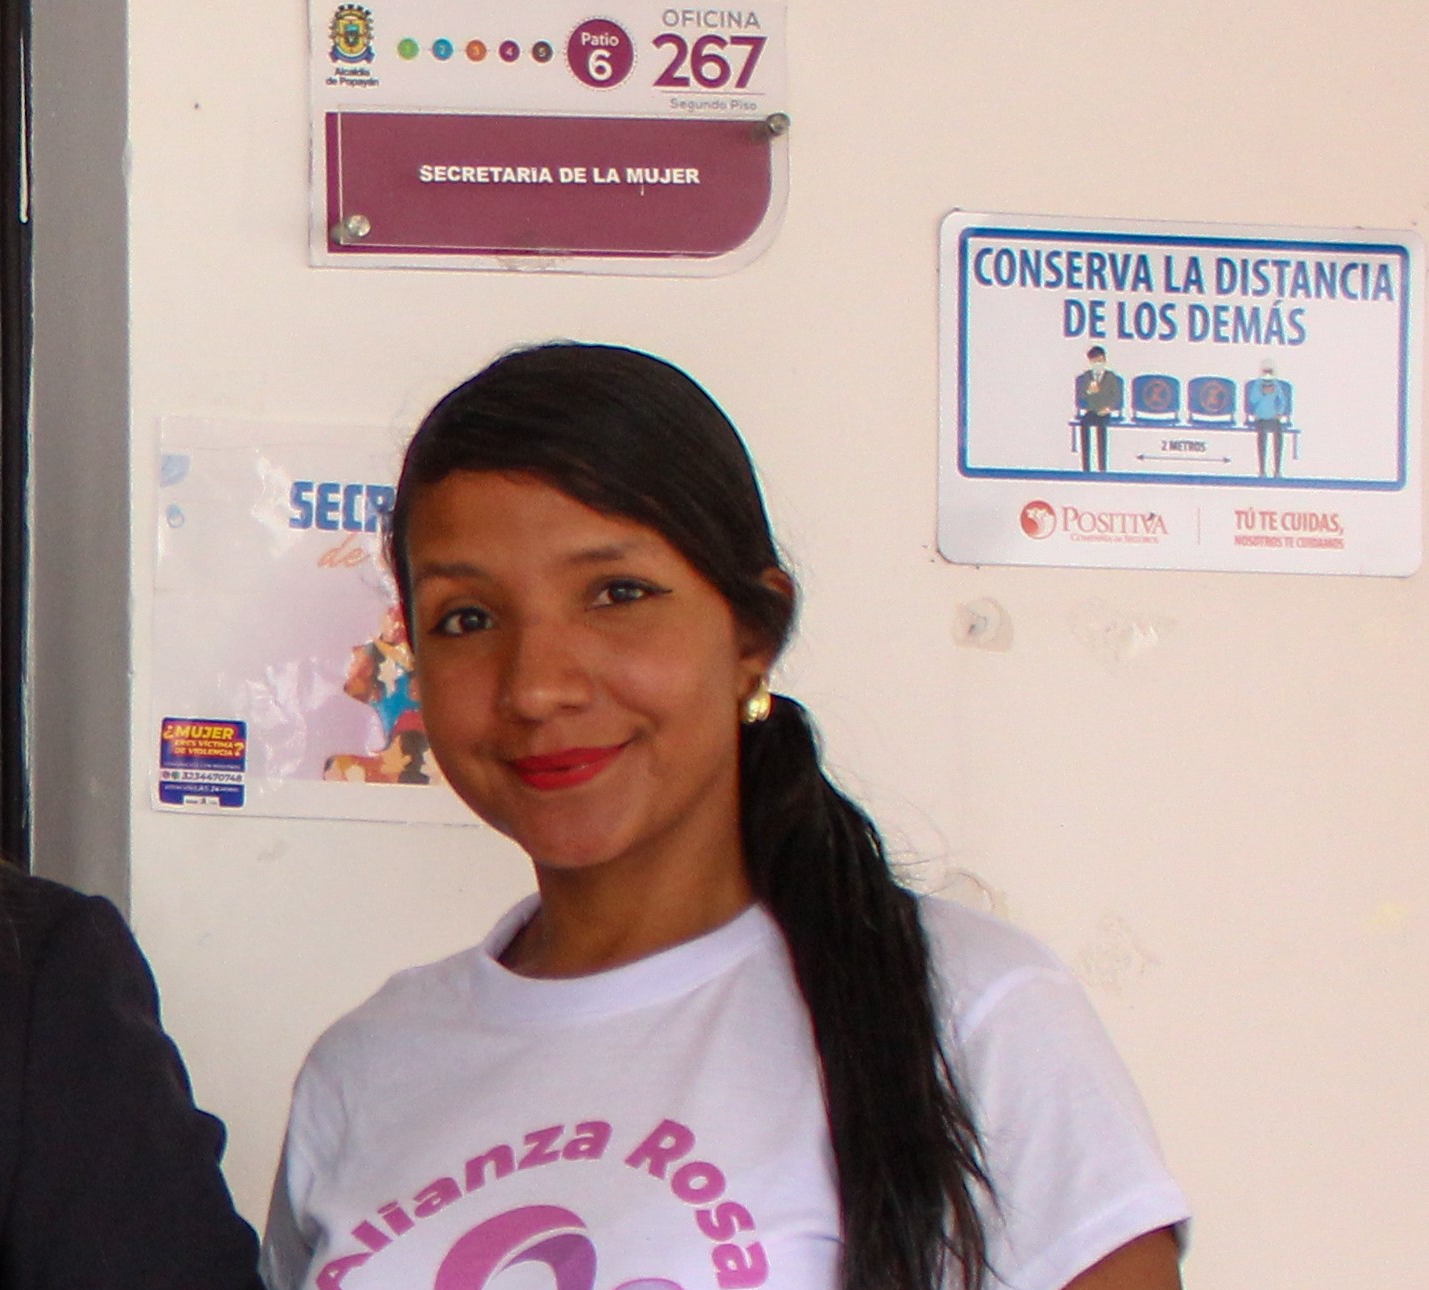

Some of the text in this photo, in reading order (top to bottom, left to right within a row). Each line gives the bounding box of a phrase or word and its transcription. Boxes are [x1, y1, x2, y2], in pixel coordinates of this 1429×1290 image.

[662, 9, 761, 29] OFICINA
[581, 32, 619, 47] Patio
[588, 49, 613, 81] 6
[652, 33, 768, 89] 267
[670, 98, 757, 112] Segundo Piso
[559, 167, 587, 183] DE
[593, 168, 620, 183] LA
[626, 168, 700, 184] MUJER
[974, 247, 1395, 301] CONSERVA LA DISTANCIA
[1064, 299, 1307, 346] DE LOS DEMÁS
[1161, 440, 1168, 451] 2
[1235, 507, 1343, 535] TÚ TE CUIDAS,
[318, 534, 369, 567] de
[624, 1118, 769, 1290] Rosa
